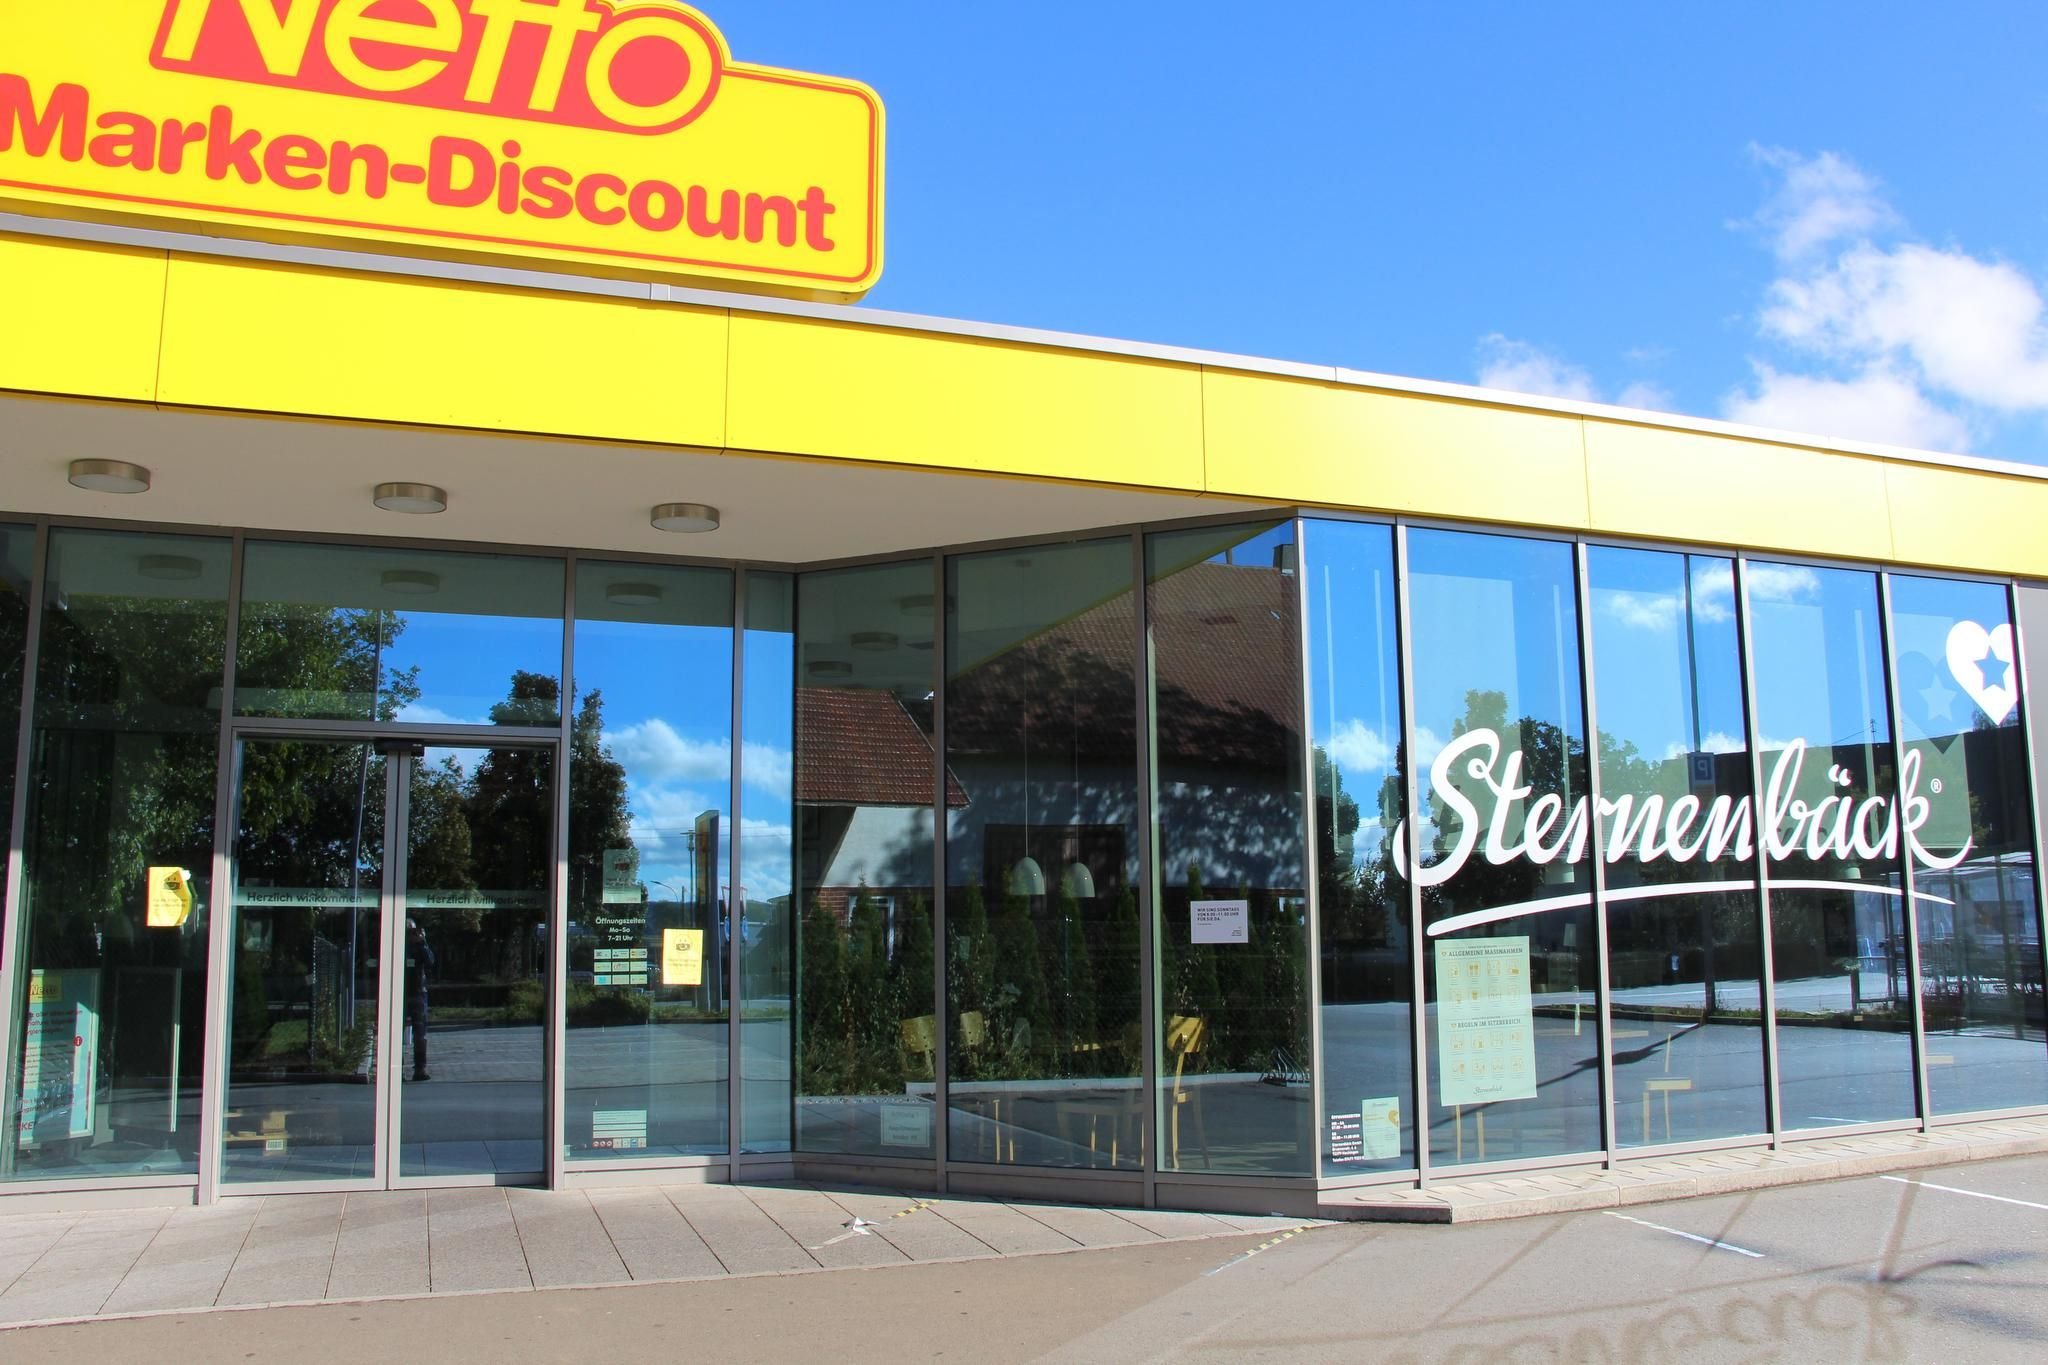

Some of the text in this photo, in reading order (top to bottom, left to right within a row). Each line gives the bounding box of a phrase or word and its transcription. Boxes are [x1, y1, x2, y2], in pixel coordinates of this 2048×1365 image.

[0, 72, 836, 252] Marken-Discount
[247, 891, 293, 903] Herzlich
[595, 915, 646, 926] Öffnungszeiten
